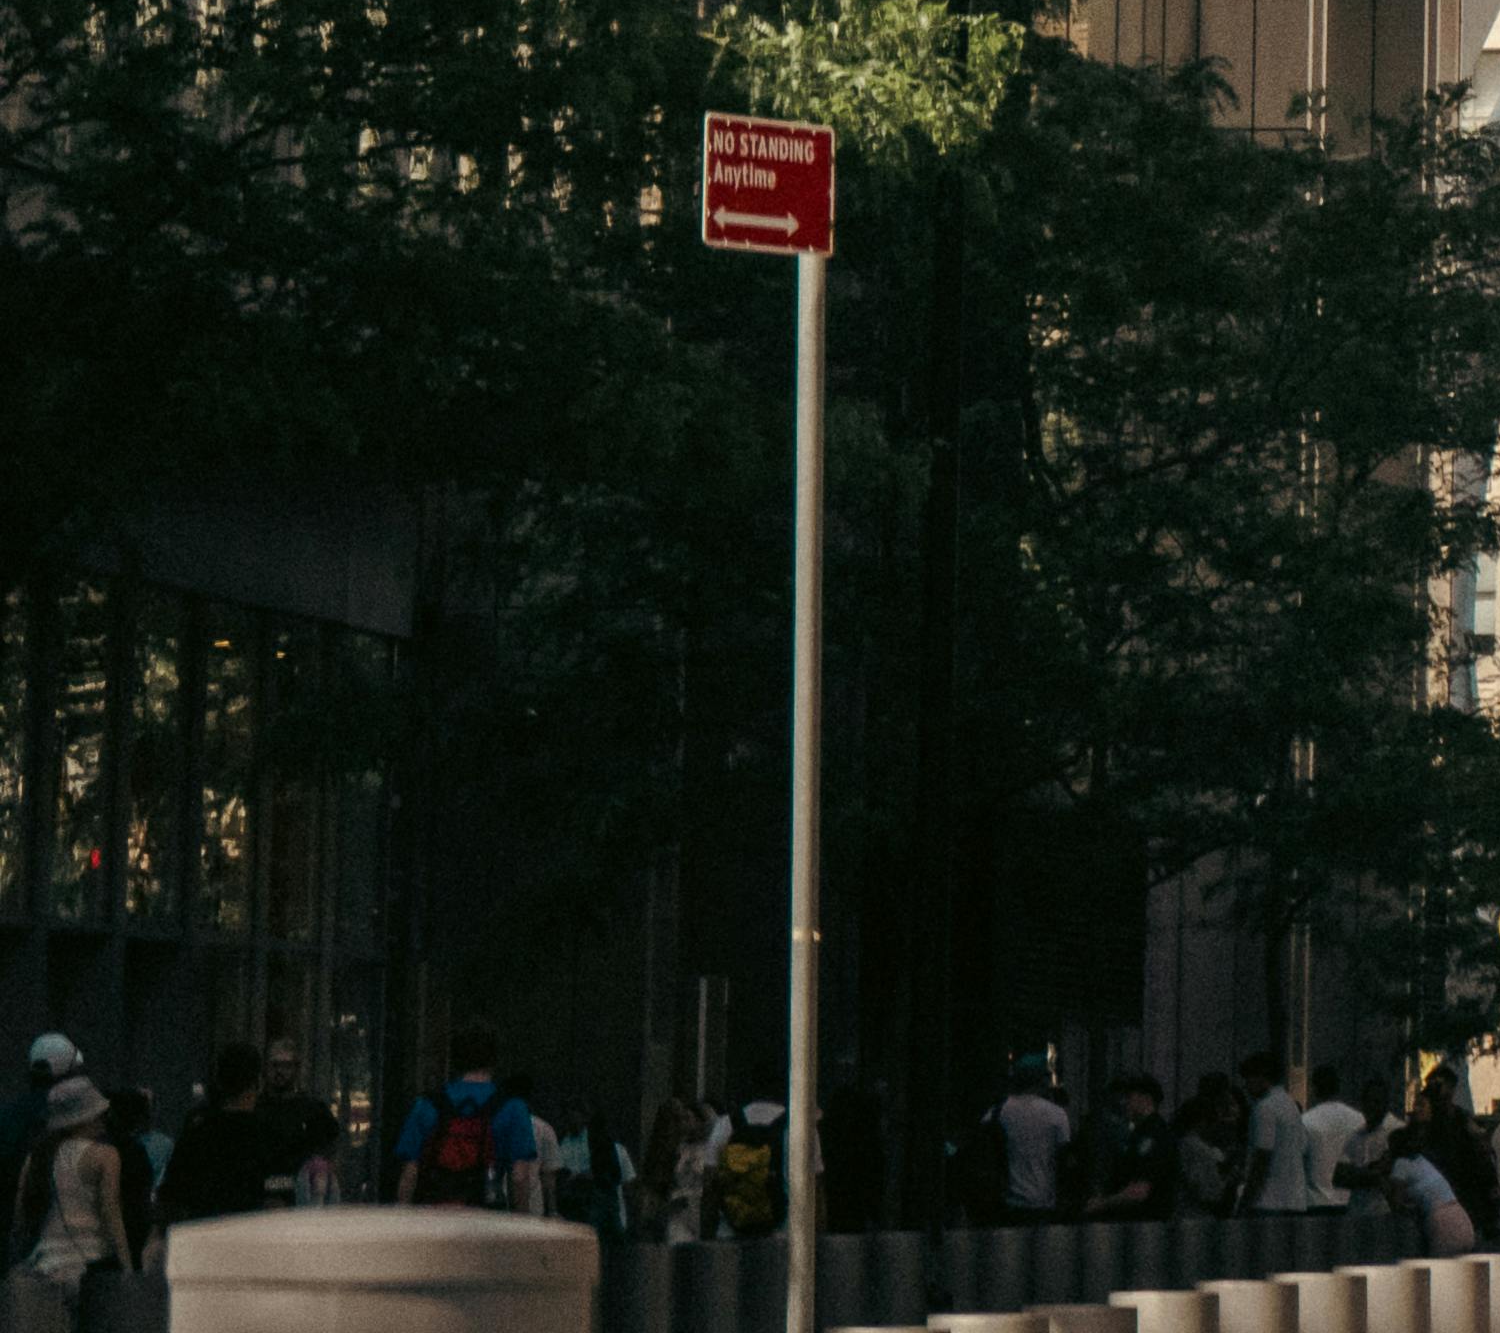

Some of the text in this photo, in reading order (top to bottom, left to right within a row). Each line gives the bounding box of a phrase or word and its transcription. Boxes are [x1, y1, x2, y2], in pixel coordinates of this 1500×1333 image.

[714, 130, 815, 165] NO STANDING
[714, 160, 777, 192] Anytime
